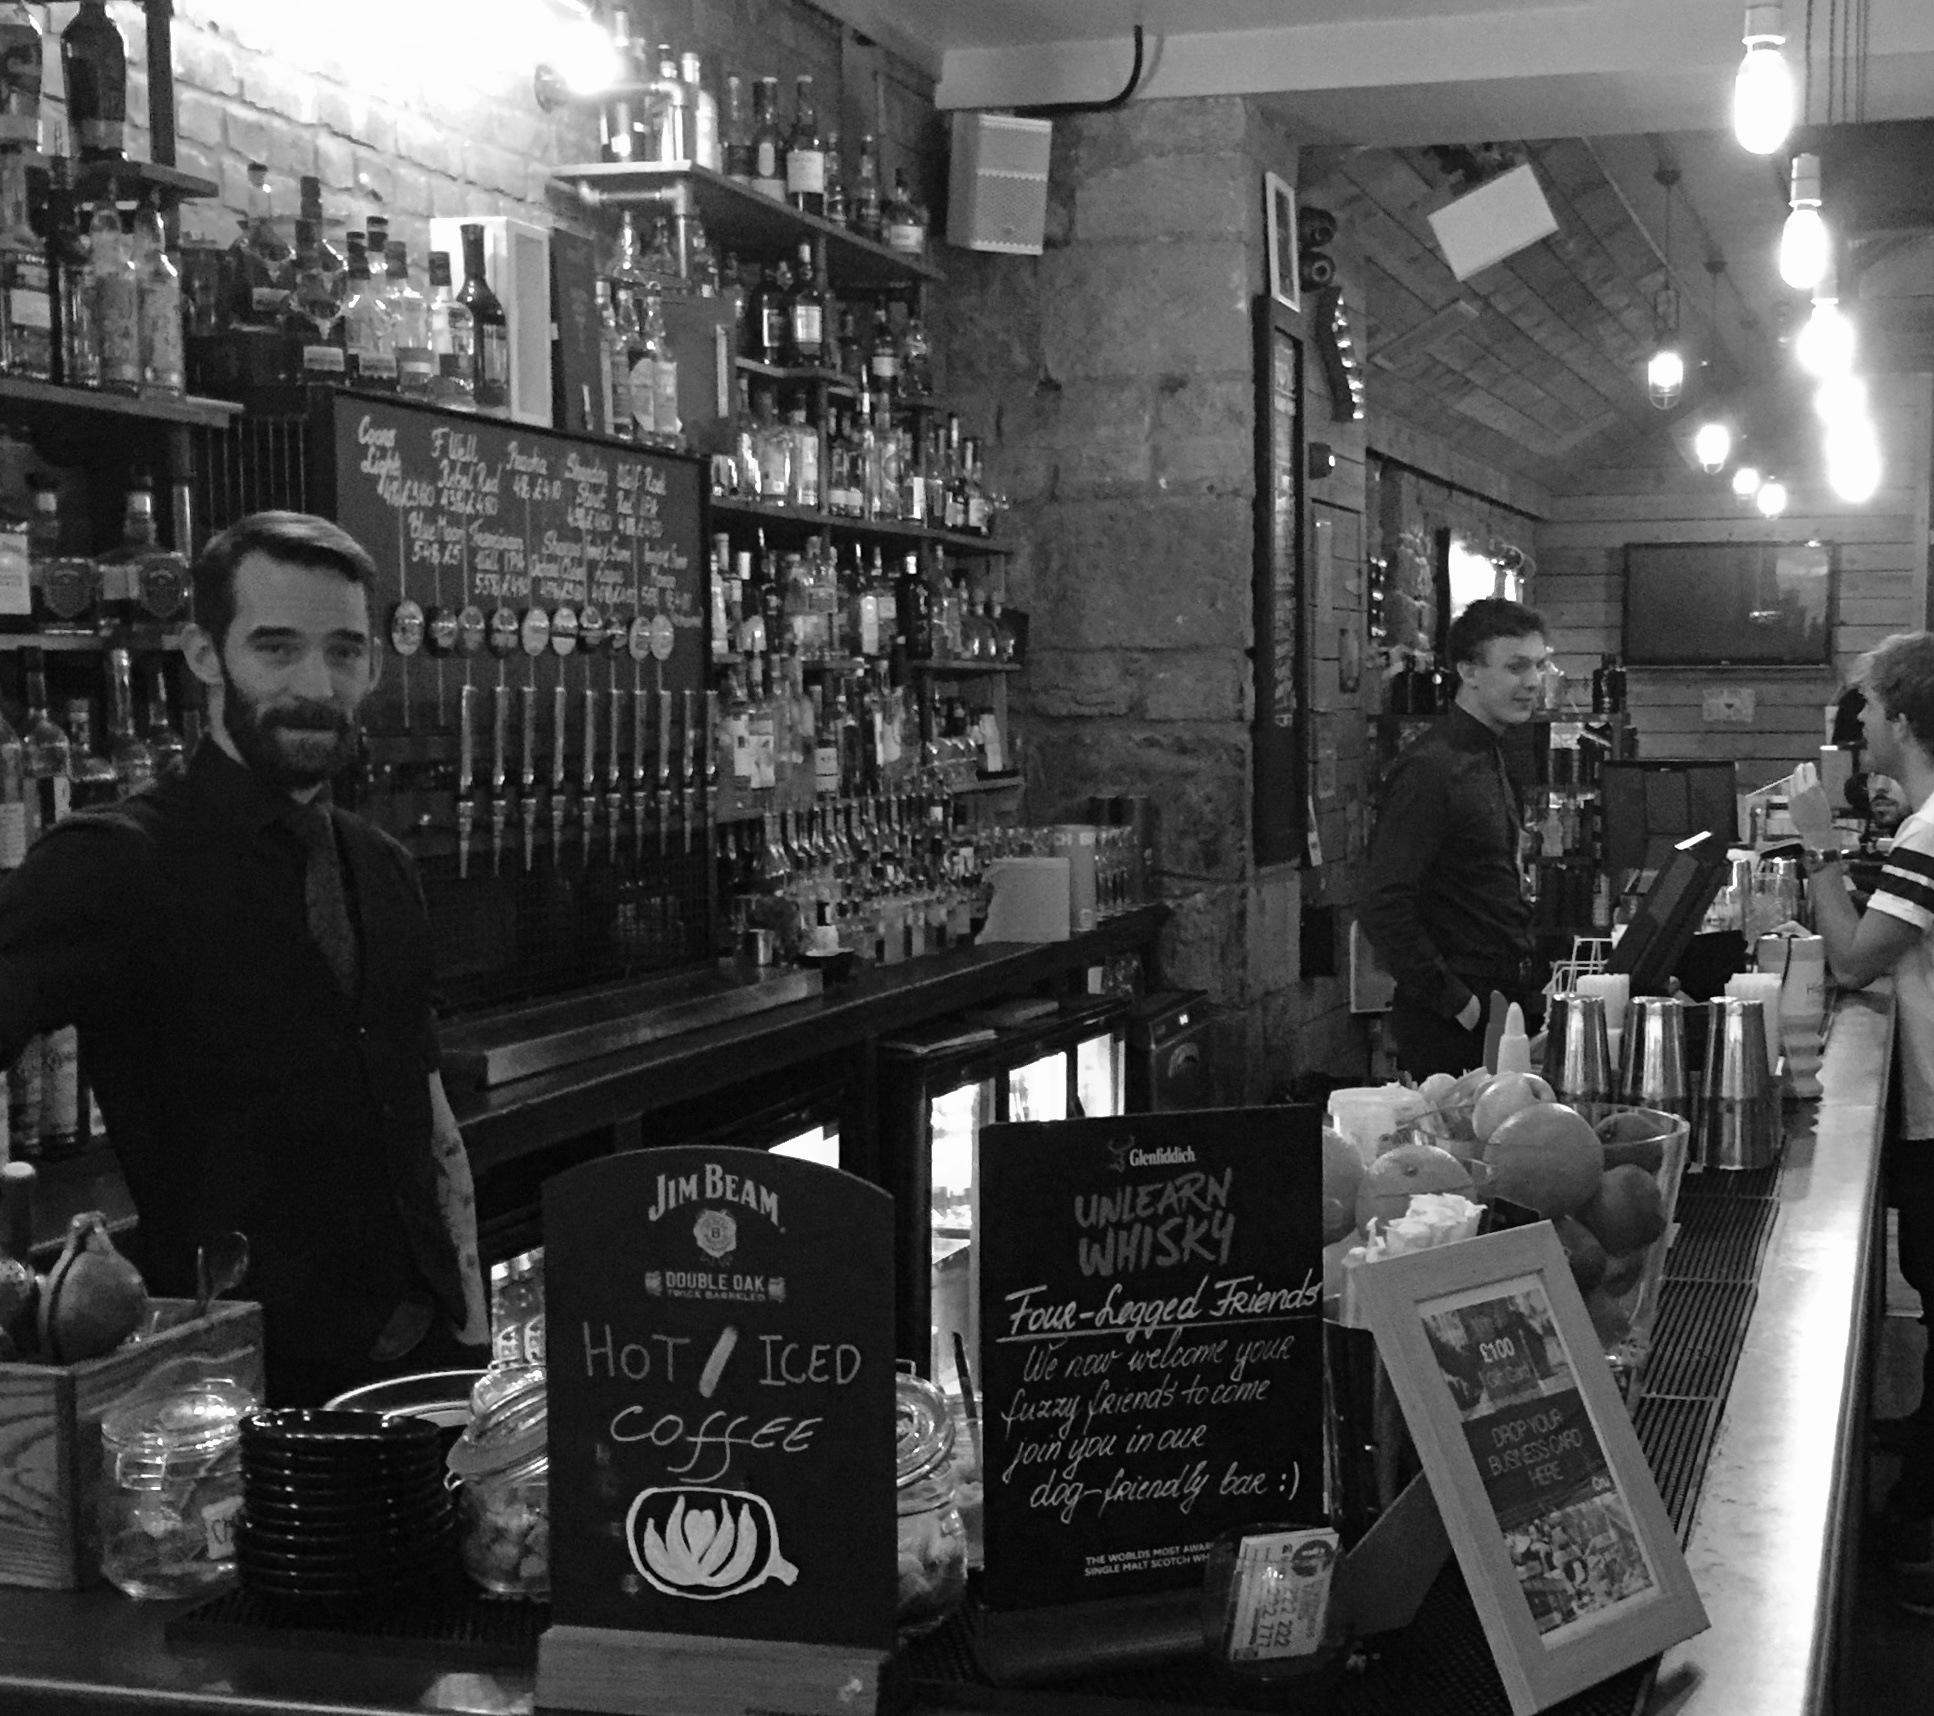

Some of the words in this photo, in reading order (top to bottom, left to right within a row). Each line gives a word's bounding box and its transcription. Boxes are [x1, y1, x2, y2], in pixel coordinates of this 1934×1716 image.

[1129, 1144, 1198, 1167] Glenfiddich
[648, 1173, 698, 1222] JIM
[704, 1163, 780, 1227] BEAM
[1075, 1166, 1232, 1229] UNLEARN
[1078, 1210, 1236, 1277] WHISKY
[665, 1271, 728, 1291] DOUBLE
[733, 1274, 765, 1292] OAK
[583, 1321, 691, 1382] HOT
[759, 1335, 861, 1386] ICED
[1024, 1337, 1067, 1382] We
[1064, 1350, 1122, 1379] now
[1128, 1328, 1229, 1372] welcome
[1231, 1335, 1296, 1382] your
[1479, 1337, 1515, 1363] £100
[1001, 1388, 1080, 1441] fuzzy
[1083, 1374, 1178, 1435] friends
[1491, 1419, 1526, 1447] DROP
[1526, 1408, 1564, 1434] YOUR
[1550, 1428, 1584, 1454] CARD
[1001, 1440, 1061, 1484] join
[1063, 1434, 1117, 1479] you
[1126, 1424, 1153, 1454] in
[1528, 1461, 1564, 1487] HERE
[1084, 1564, 1120, 1577] SINGLE
[1122, 1560, 1149, 1572] MALT
[1151, 1555, 1191, 1569] SCOTCH
[1085, 1556, 1106, 1566] THE
[1152, 1545, 1180, 1558] MOST
